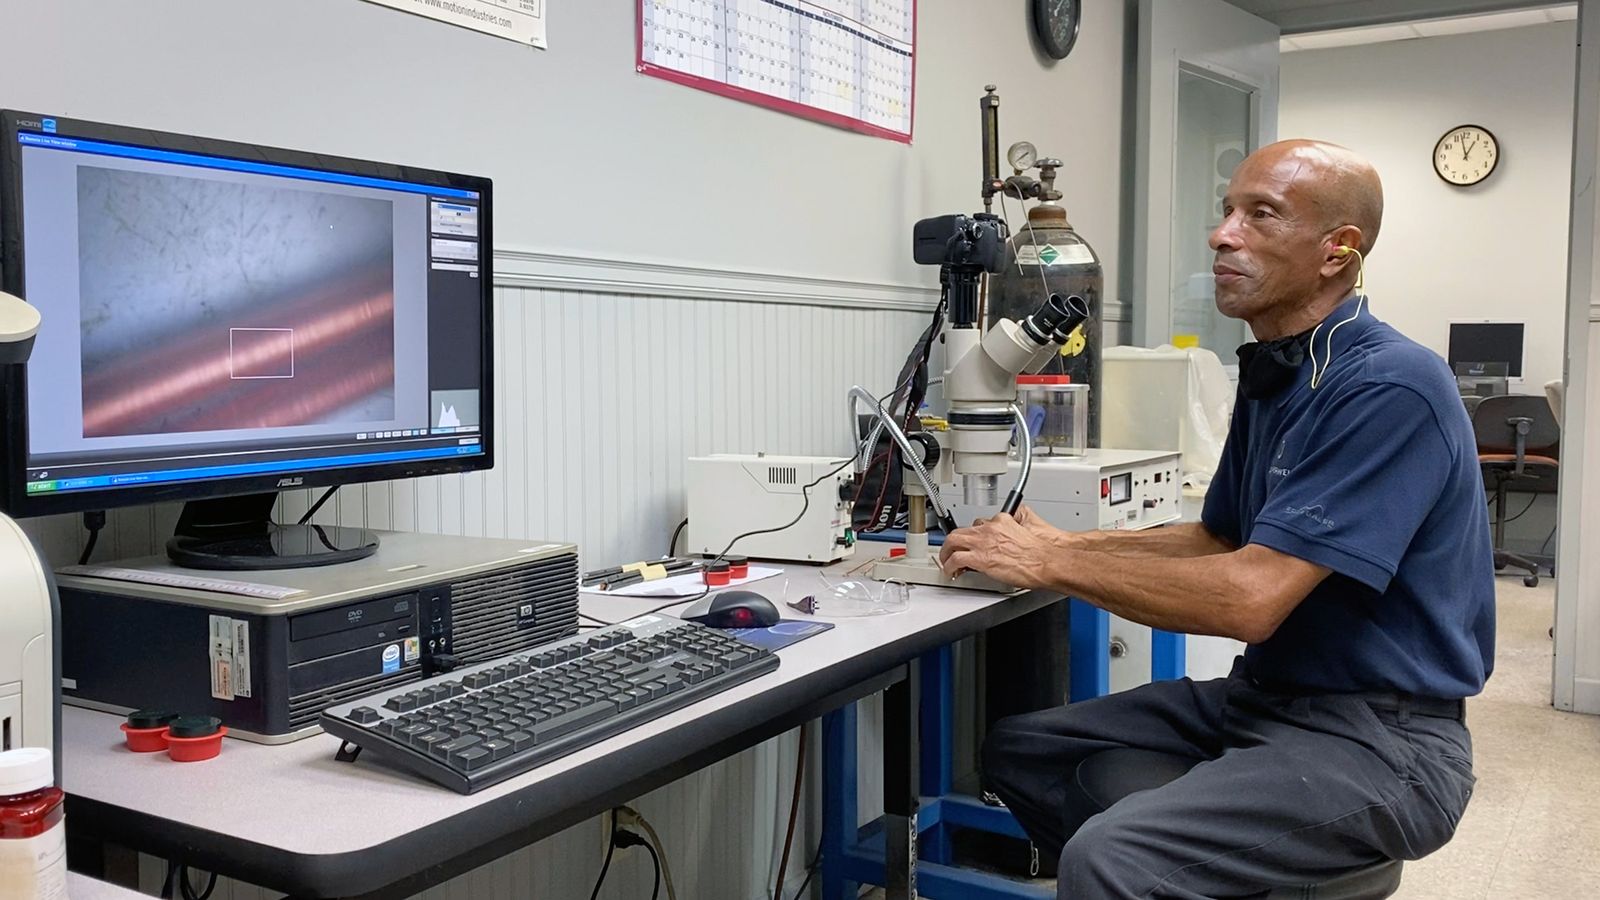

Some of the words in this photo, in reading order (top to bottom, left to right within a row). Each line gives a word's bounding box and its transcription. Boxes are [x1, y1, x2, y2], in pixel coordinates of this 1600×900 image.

[276, 477, 303, 487] ASUS
[863, 505, 892, 533] non
[348, 609, 363, 617] DVD
